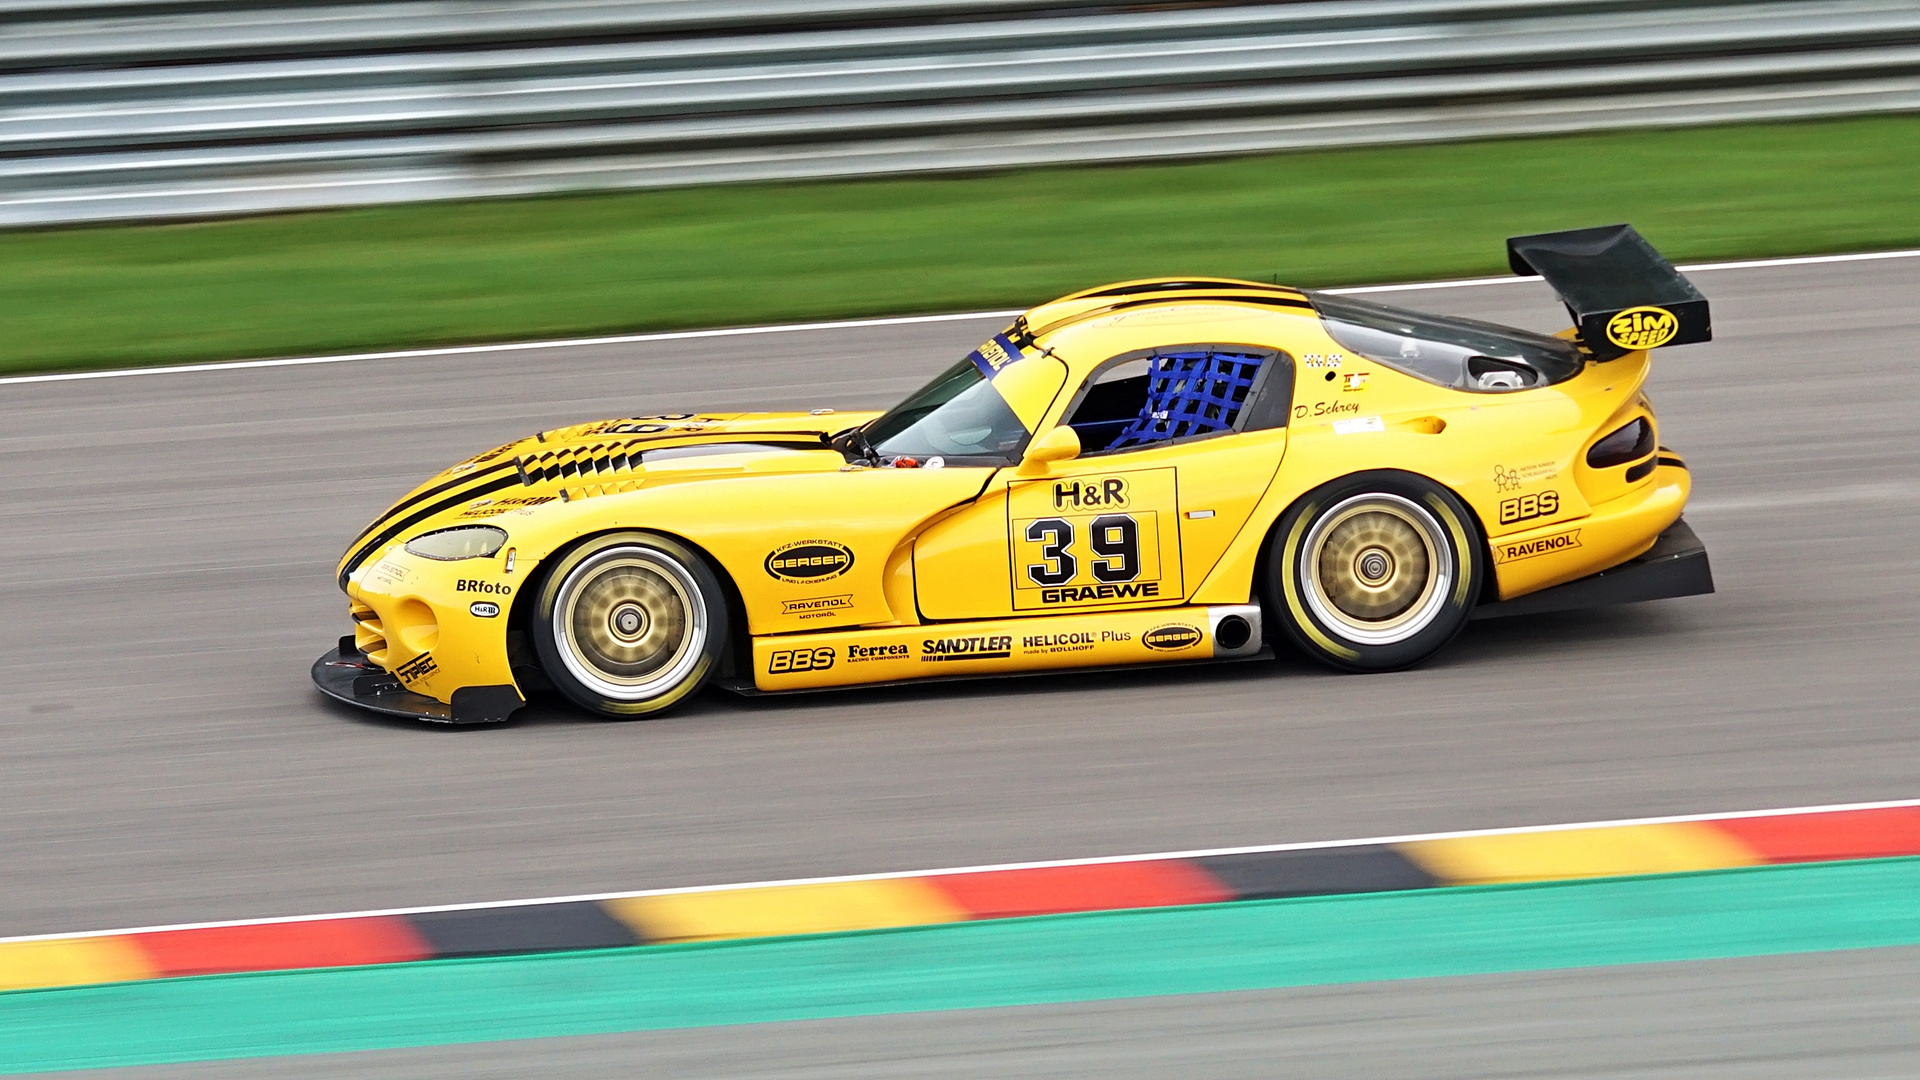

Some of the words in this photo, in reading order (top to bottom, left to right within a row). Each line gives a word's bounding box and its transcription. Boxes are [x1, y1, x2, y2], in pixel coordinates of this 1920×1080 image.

[1618, 329, 1669, 346] SPEED
[1056, 479, 1124, 508] H&R
[1500, 490, 1559, 525] BBS
[777, 539, 843, 553] KFZ-WERKSTATT
[1025, 513, 1141, 587] 39
[1507, 535, 1574, 559] RAVENOL
[772, 554, 847, 569] BERGER
[456, 579, 512, 595] BRfoto
[1042, 583, 1160, 603] GRAEWE
[789, 599, 847, 610] RAVENOL
[799, 611, 836, 619] MOTORÖL
[1101, 630, 1132, 642] Plus
[848, 644, 908, 658] Ferrea
[922, 636, 1012, 655] SANDTLER
[768, 647, 836, 675] BBS
